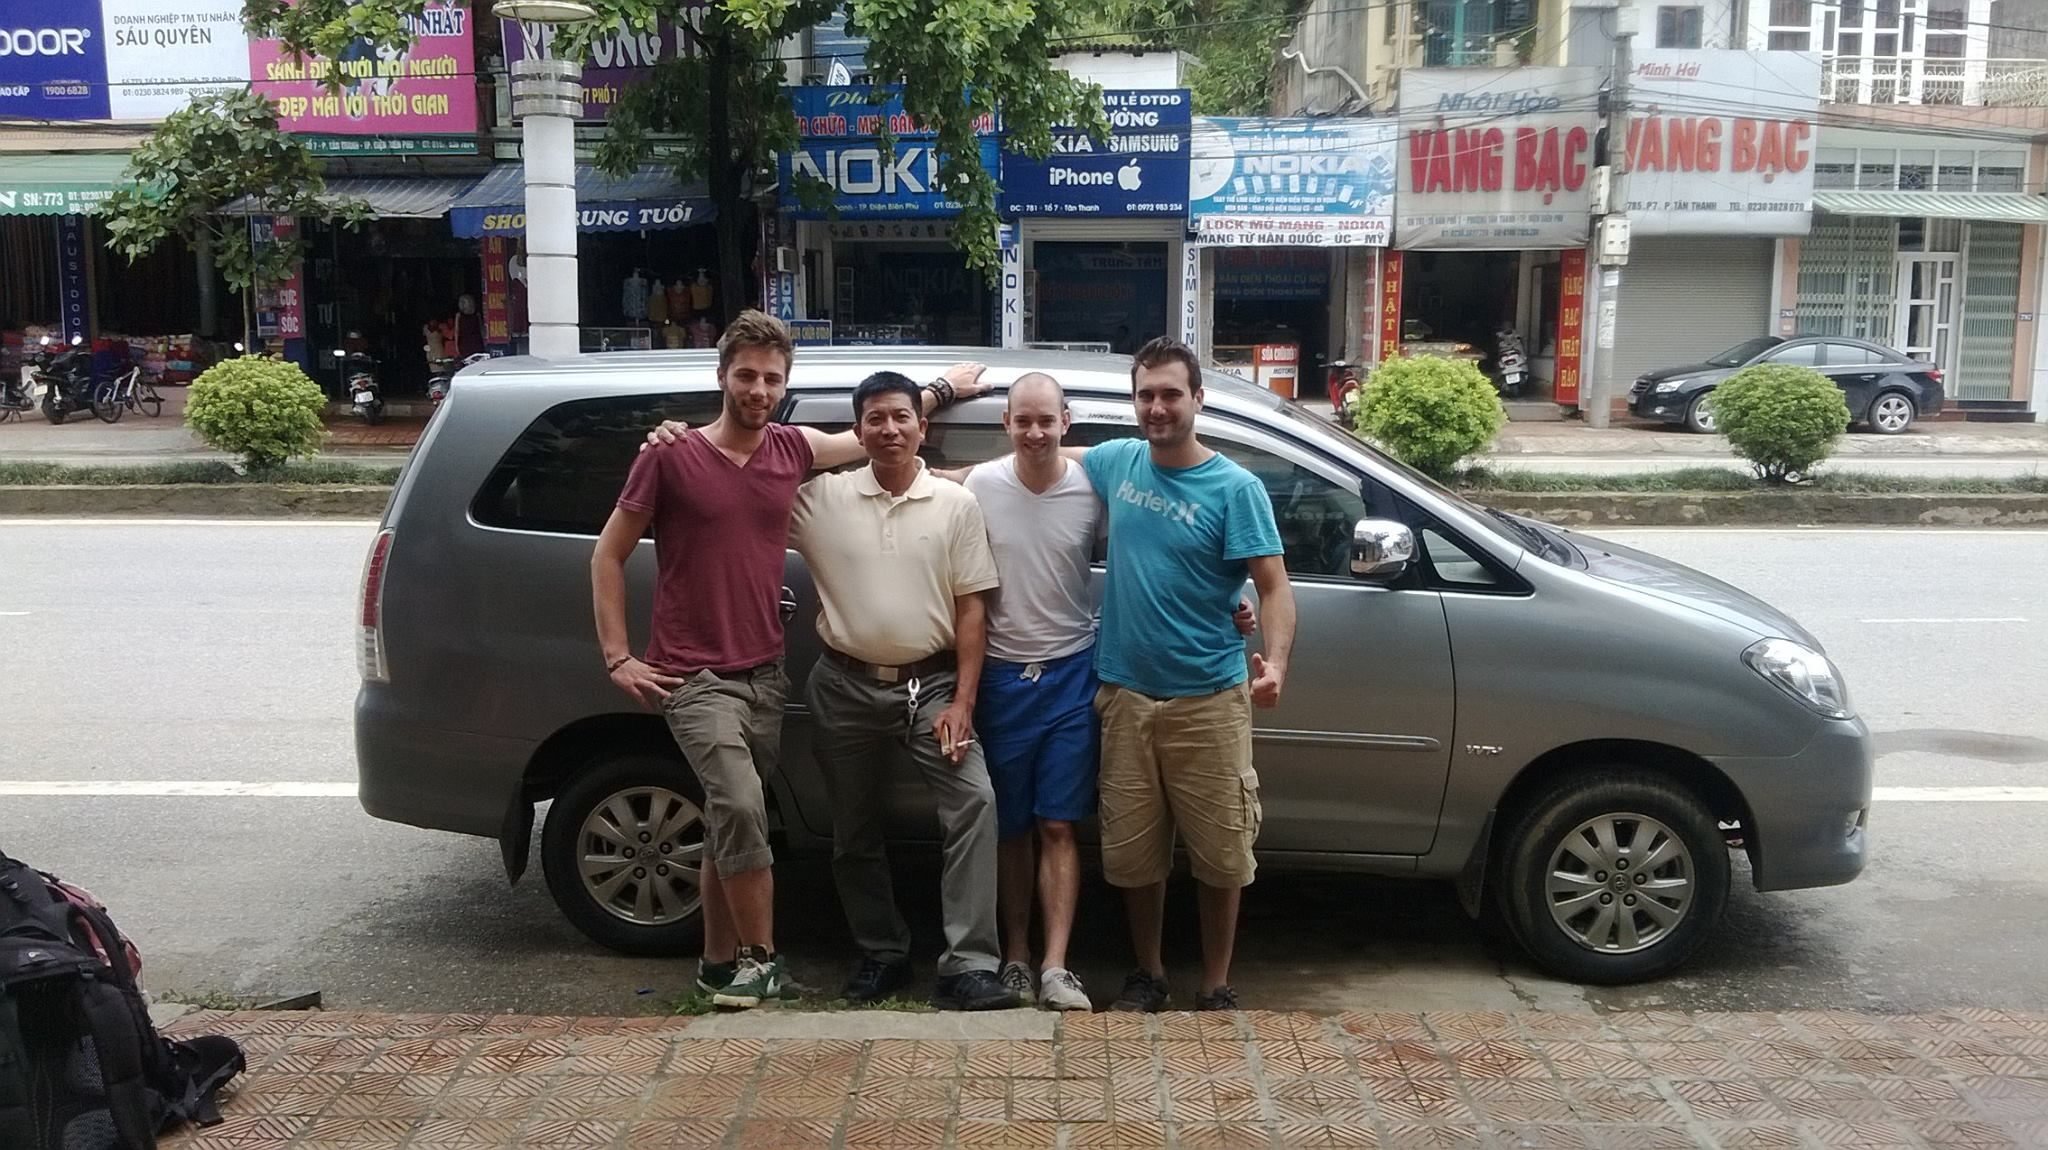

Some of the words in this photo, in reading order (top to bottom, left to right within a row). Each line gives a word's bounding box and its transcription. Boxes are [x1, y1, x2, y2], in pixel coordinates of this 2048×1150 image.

[114, 15, 146, 25] DOANH
[147, 14, 179, 25] NGHIỆP
[181, 14, 195, 23] TM
[197, 13, 208, 23] TƯ
[209, 12, 236, 22] NHÂN
[421, 2, 465, 37] NHẤT
[115, 25, 149, 46] SÁU
[154, 24, 212, 48] QUYÊN
[45, 86, 66, 96] 1900
[592, 82, 609, 104] PHỐ
[279, 97, 307, 121] ĐẸP
[373, 92, 408, 117] THỜI
[411, 95, 449, 116] GIAN
[811, 112, 847, 136] CHỮA
[1109, 135, 1180, 152] SAMSUNG
[1731, 118, 1811, 184] BẠC
[791, 148, 970, 195] NOKI
[1242, 155, 1368, 175] NOKIA
[1410, 114, 1504, 194] VÀNG
[1514, 126, 1588, 205] BẠC
[1050, 168, 1114, 186] iPhone
[482, 214, 526, 230] SHO
[576, 210, 629, 226] UNG
[639, 201, 693, 224] TUỔI
[1691, 202, 1717, 211] THANH
[1206, 219, 1244, 230] LOCK
[1338, 219, 1385, 230] NOKIA
[66, 231, 82, 338] AUSTDOO
[1004, 247, 1018, 350] NOKI
[1116, 479, 1176, 517] Hurley
